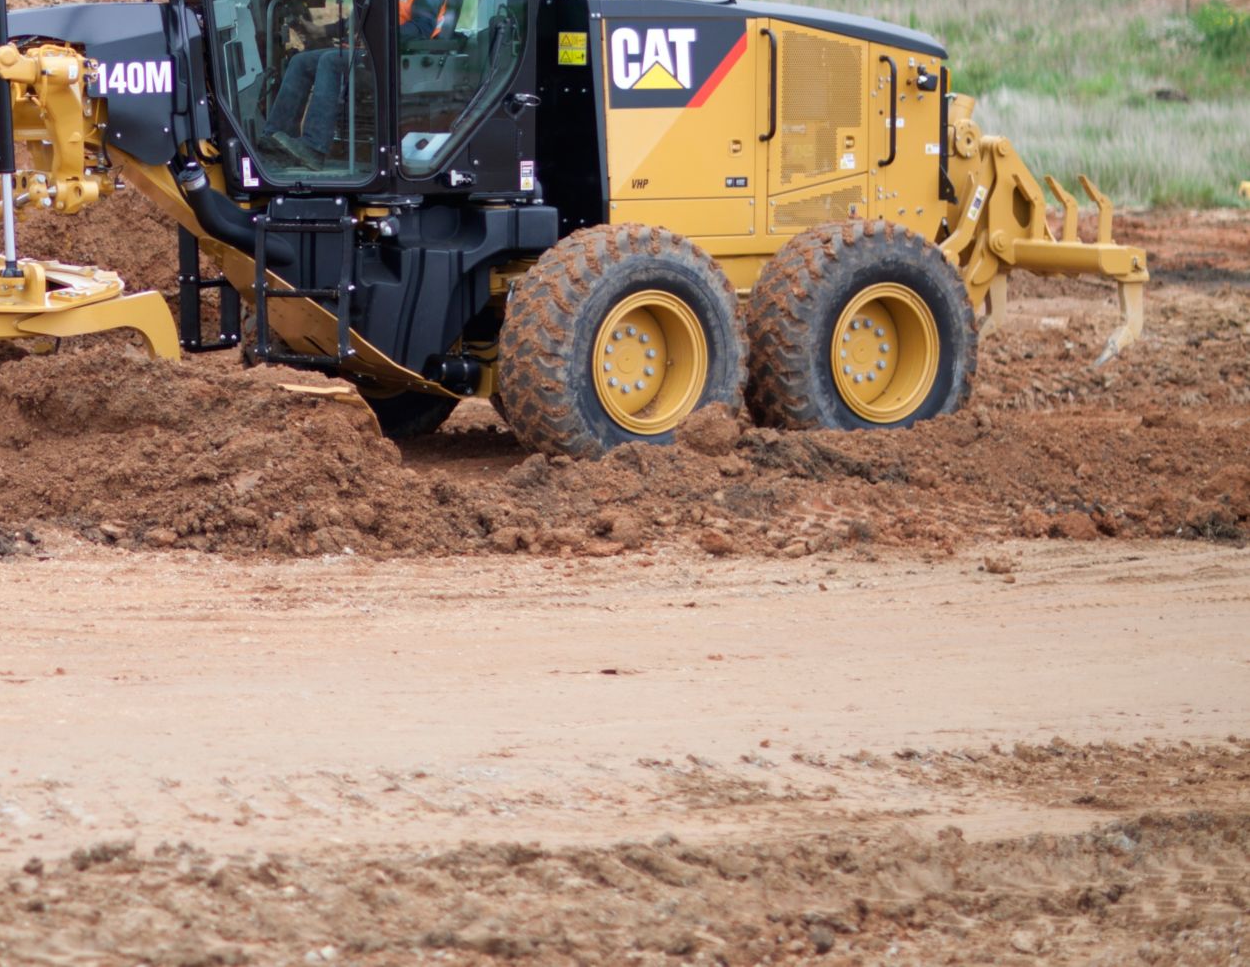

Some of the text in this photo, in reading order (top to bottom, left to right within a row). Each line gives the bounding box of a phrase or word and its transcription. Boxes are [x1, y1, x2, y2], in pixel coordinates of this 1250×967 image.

[611, 27, 696, 90] CAT
[97, 60, 173, 95] 140M
[631, 178, 649, 189] VHP
